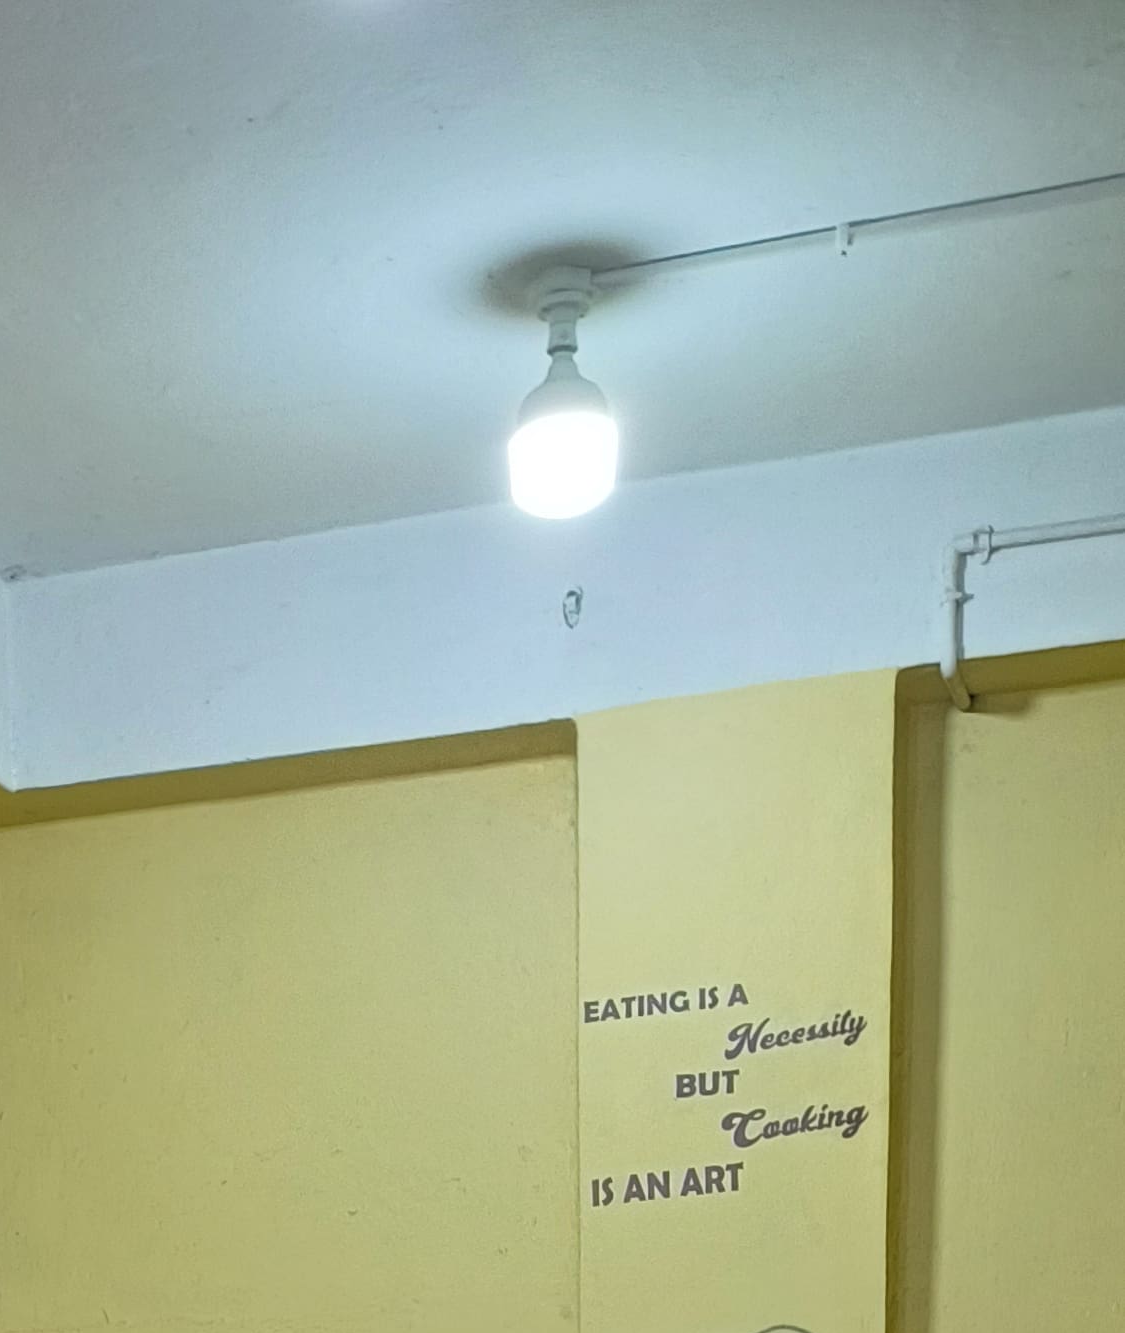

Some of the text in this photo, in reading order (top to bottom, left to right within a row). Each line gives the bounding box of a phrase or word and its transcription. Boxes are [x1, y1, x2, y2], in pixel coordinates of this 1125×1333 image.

[583, 983, 749, 1024] EATING IS A
[724, 1009, 868, 1060] Necessity
[675, 1068, 740, 1099] BUT
[721, 1104, 869, 1148] Cooking
[591, 1161, 744, 1207] IS AN ART
